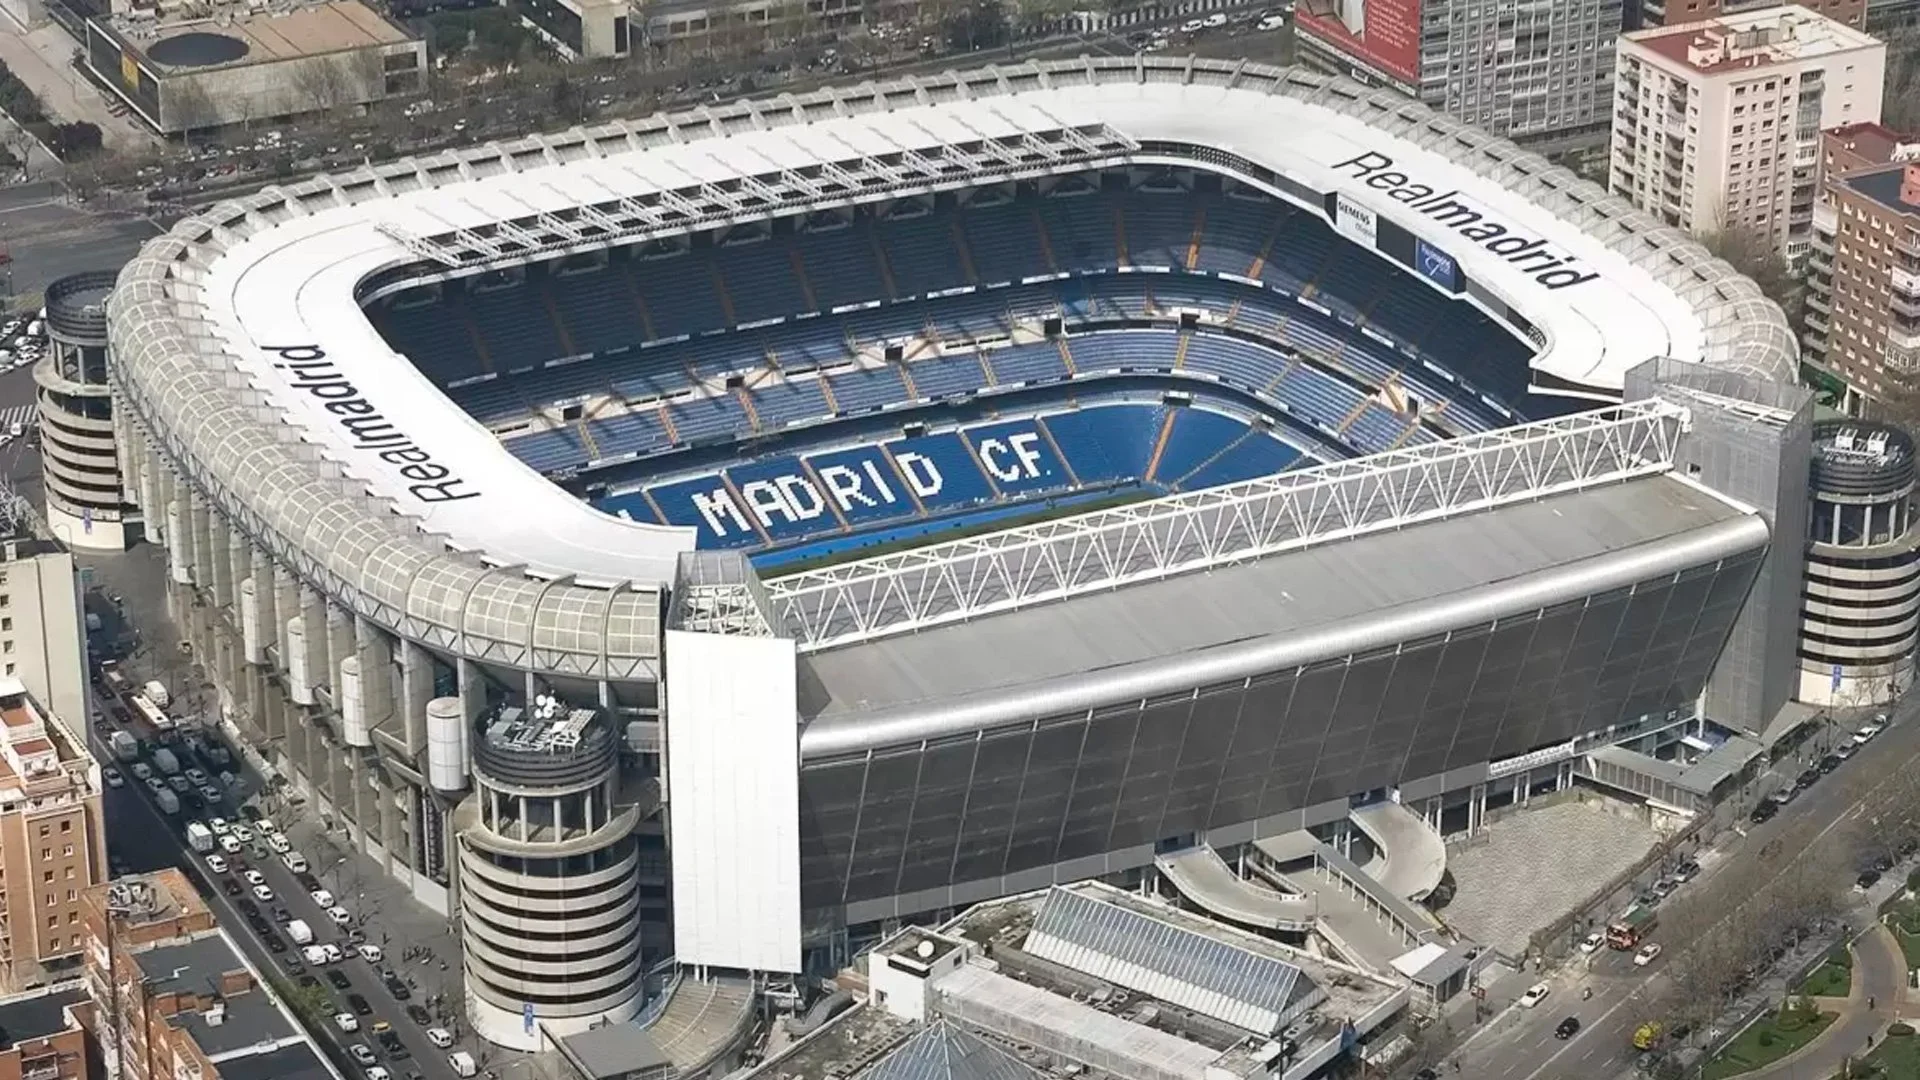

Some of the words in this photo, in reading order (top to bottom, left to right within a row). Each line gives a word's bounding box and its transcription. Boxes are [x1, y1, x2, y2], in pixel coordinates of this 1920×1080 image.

[1332, 150, 1601, 290] Realmadrid
[260, 344, 482, 502] Realmadrid
[691, 451, 943, 537] MADRID
